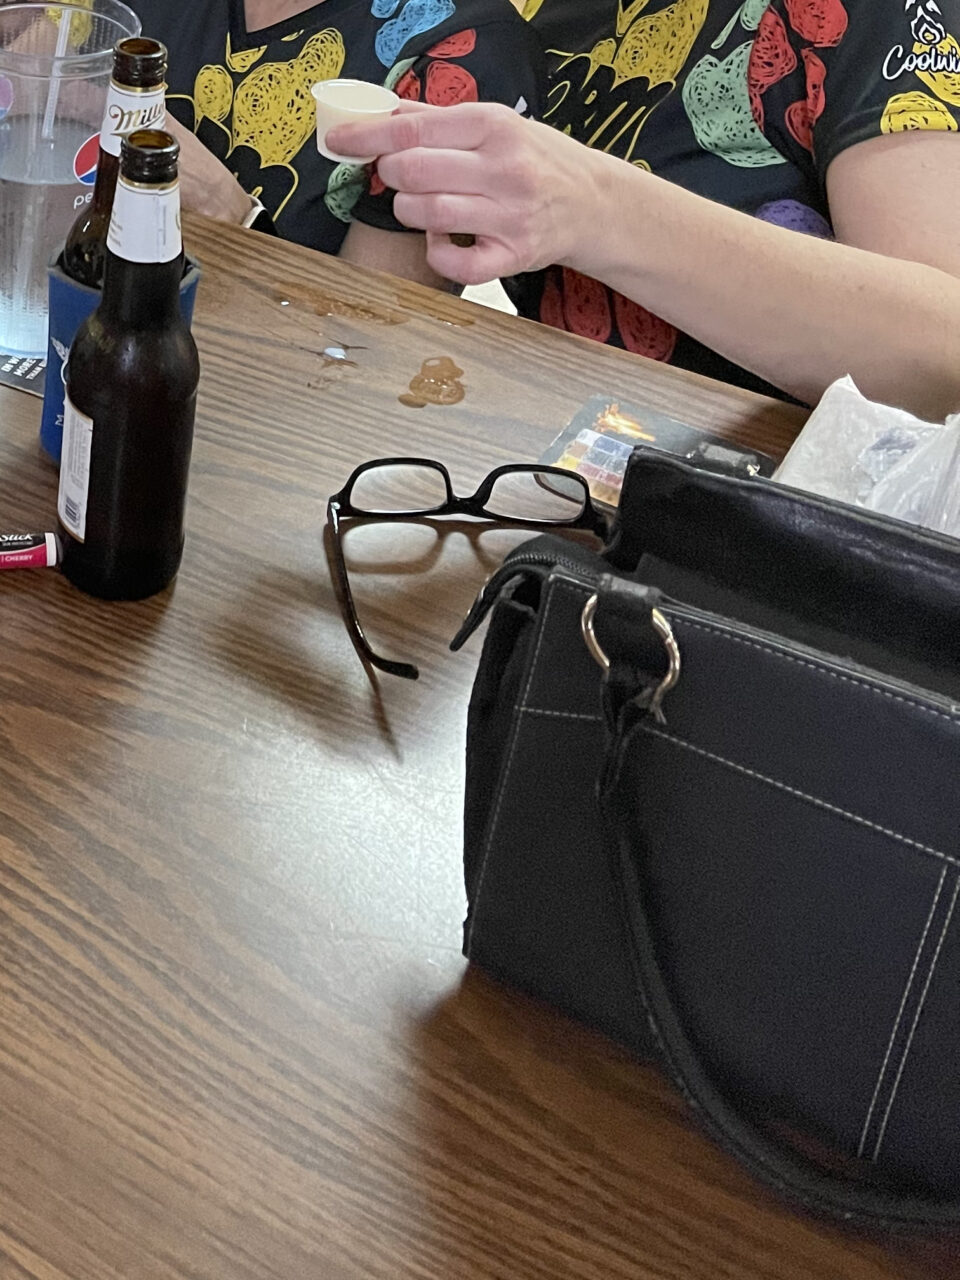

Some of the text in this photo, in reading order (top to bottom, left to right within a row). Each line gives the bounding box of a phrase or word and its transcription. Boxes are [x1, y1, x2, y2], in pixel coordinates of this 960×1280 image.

[110, 103, 165, 130] Mill
[13, 358, 37, 377] MORE
[5, 554, 33, 562] CHERRY
